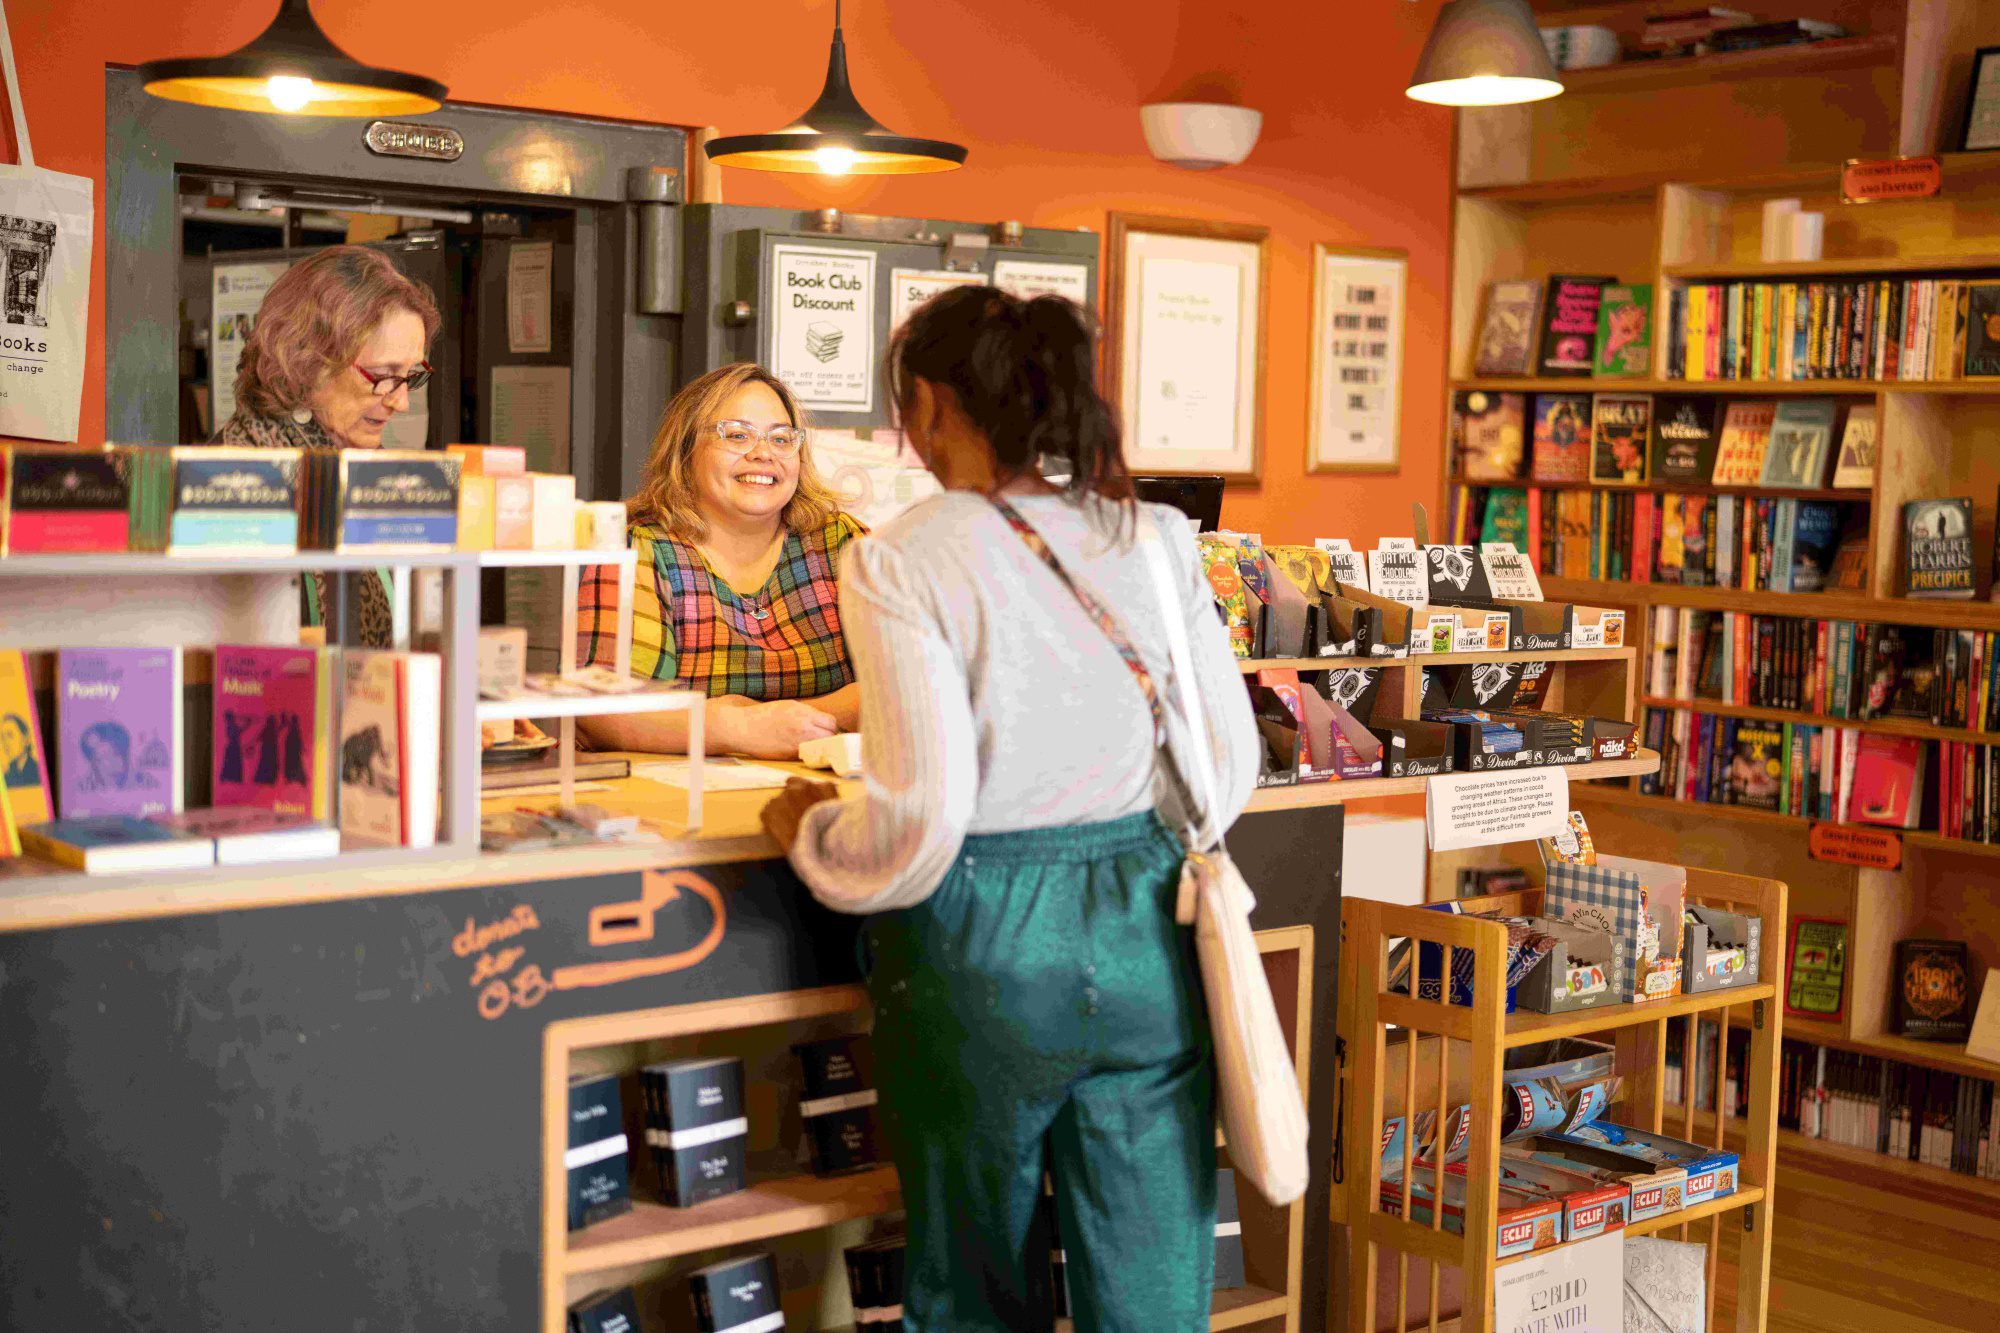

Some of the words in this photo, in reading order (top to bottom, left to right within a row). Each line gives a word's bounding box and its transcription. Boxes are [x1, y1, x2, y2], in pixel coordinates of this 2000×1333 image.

[380, 130, 453, 152] CHUBB
[788, 271, 825, 288] Book
[829, 274, 862, 291] Club
[793, 293, 855, 312] Discount
[0, 334, 47, 353] ooks
[7, 362, 44, 374] change
[1911, 540, 1970, 554] ROBERT
[1380, 552, 1399, 564] OAT
[1486, 554, 1503, 565] OAT
[1911, 553, 1971, 570] HARRIS
[1911, 570, 1970, 589] PRECIPICE
[67, 680, 121, 702] Poetry
[222, 677, 265, 697] Music
[1454, 783, 1480, 793] Chocolate
[1480, 781, 1496, 791] prices
[1496, 780, 1508, 788] have
[1508, 776, 1531, 786] increased
[1532, 775, 1541, 783] due
[1460, 792, 1483, 802] changing
[1483, 789, 1503, 797] weather
[1503, 785, 1523, 795] patterns
[1451, 803, 1472, 813] growing
[1472, 800, 1486, 808] areas
[1508, 795, 1523, 803] These
[1523, 792, 1544, 802] changes
[1451, 812, 1471, 821] thought
[1484, 808, 1494, 816] due
[1500, 805, 1517, 813] climate
[1537, 800, 1554, 808] Please
[1454, 820, 1475, 830] continue
[1481, 816, 1501, 826] support
[1509, 811, 1531, 820] Fairtrade
[1531, 809, 1552, 819] growers
[1486, 825, 1496, 833] this
[1496, 823, 1514, 832] difficult
[452, 903, 541, 958] donate
[1913, 967, 1956, 985] IRON
[1522, 1088, 1534, 1121] CLIF
[1692, 1175, 1713, 1191] CLIF
[1640, 1190, 1661, 1206] CLIF
[1580, 1207, 1602, 1225] CLIF
[1508, 1224, 1532, 1242] CLIF
[1531, 1289, 1547, 1313] £2
[1550, 1277, 1588, 1304] BLIND
[1553, 1304, 1588, 1330] WITH
